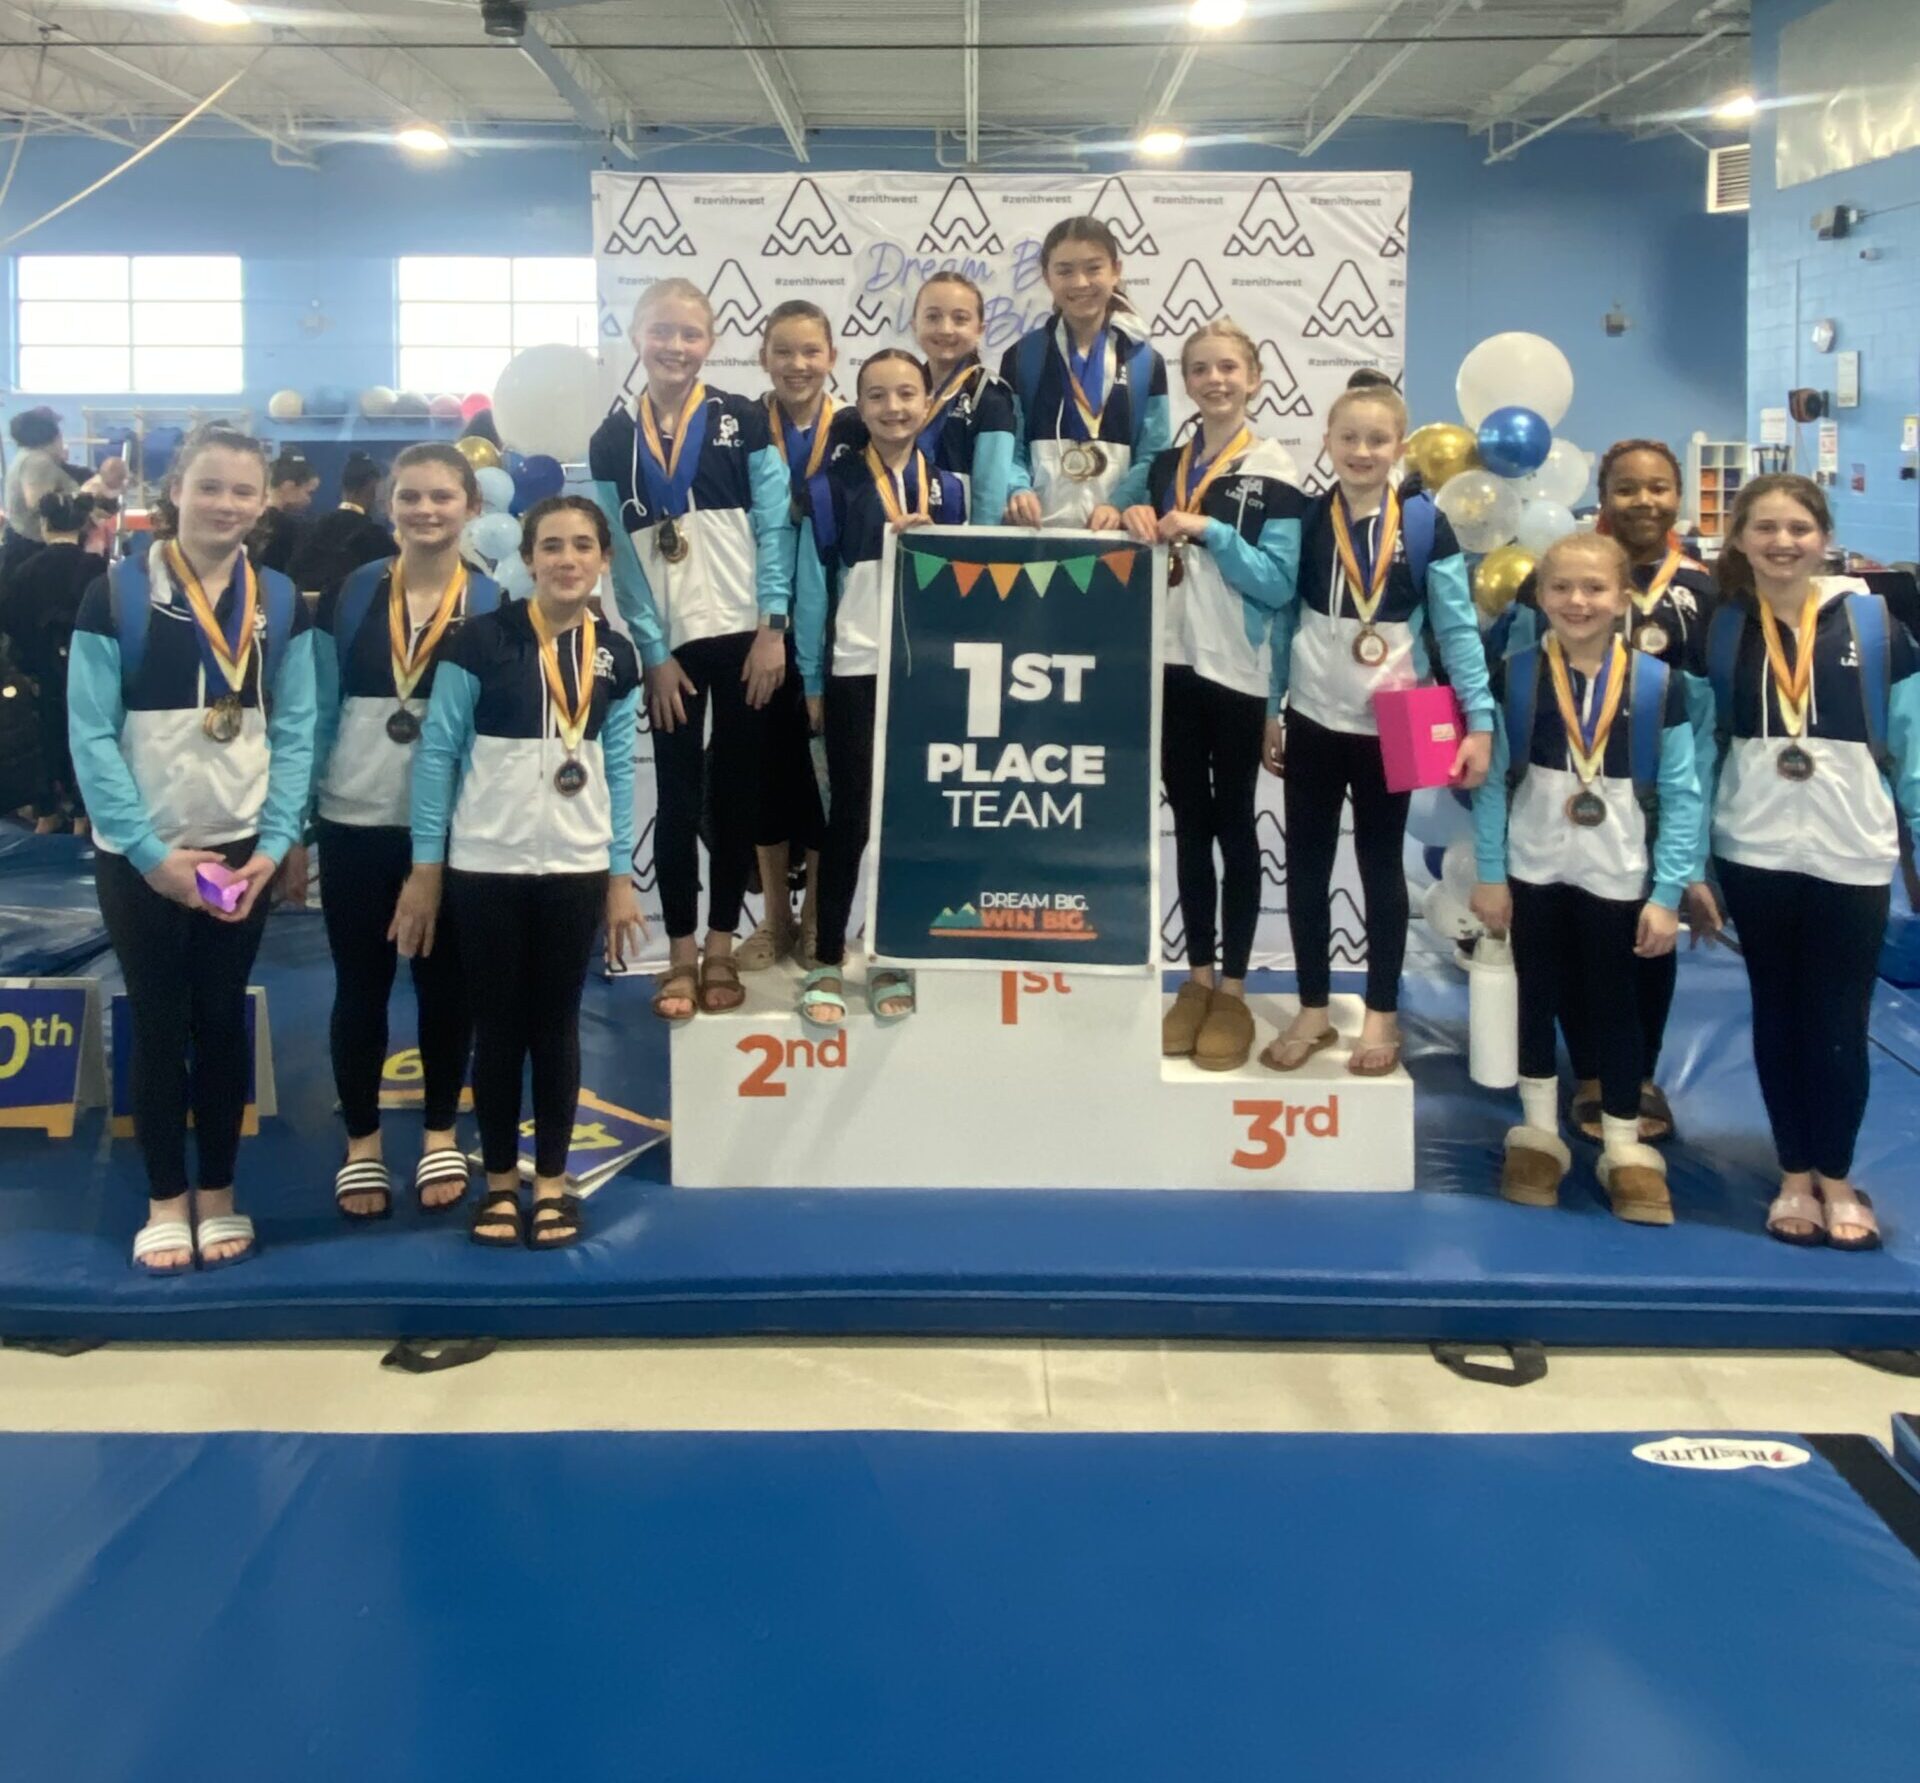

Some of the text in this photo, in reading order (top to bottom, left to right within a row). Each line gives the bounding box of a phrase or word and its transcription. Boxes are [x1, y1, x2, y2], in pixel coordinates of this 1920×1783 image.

[694, 196, 765, 205] #zenithwest
[848, 194, 918, 204] #zenithwest
[1002, 194, 1072, 204] #zenithwest
[1153, 195, 1224, 205] #zenithwest
[1310, 196, 1381, 206] #zenithwest
[775, 276, 846, 287] #zenithwest
[1231, 277, 1302, 287] #zenithwest
[1308, 357, 1380, 368] #zenithwest
[953, 642, 1096, 738] 1ST
[926, 742, 1106, 785] PLACE
[942, 790, 1083, 830] TEAM
[980, 891, 1049, 909] DREAM
[980, 908, 1035, 930] WIN
[736, 1030, 848, 1097] 2nd
[1231, 1095, 1339, 1170] 3rd
